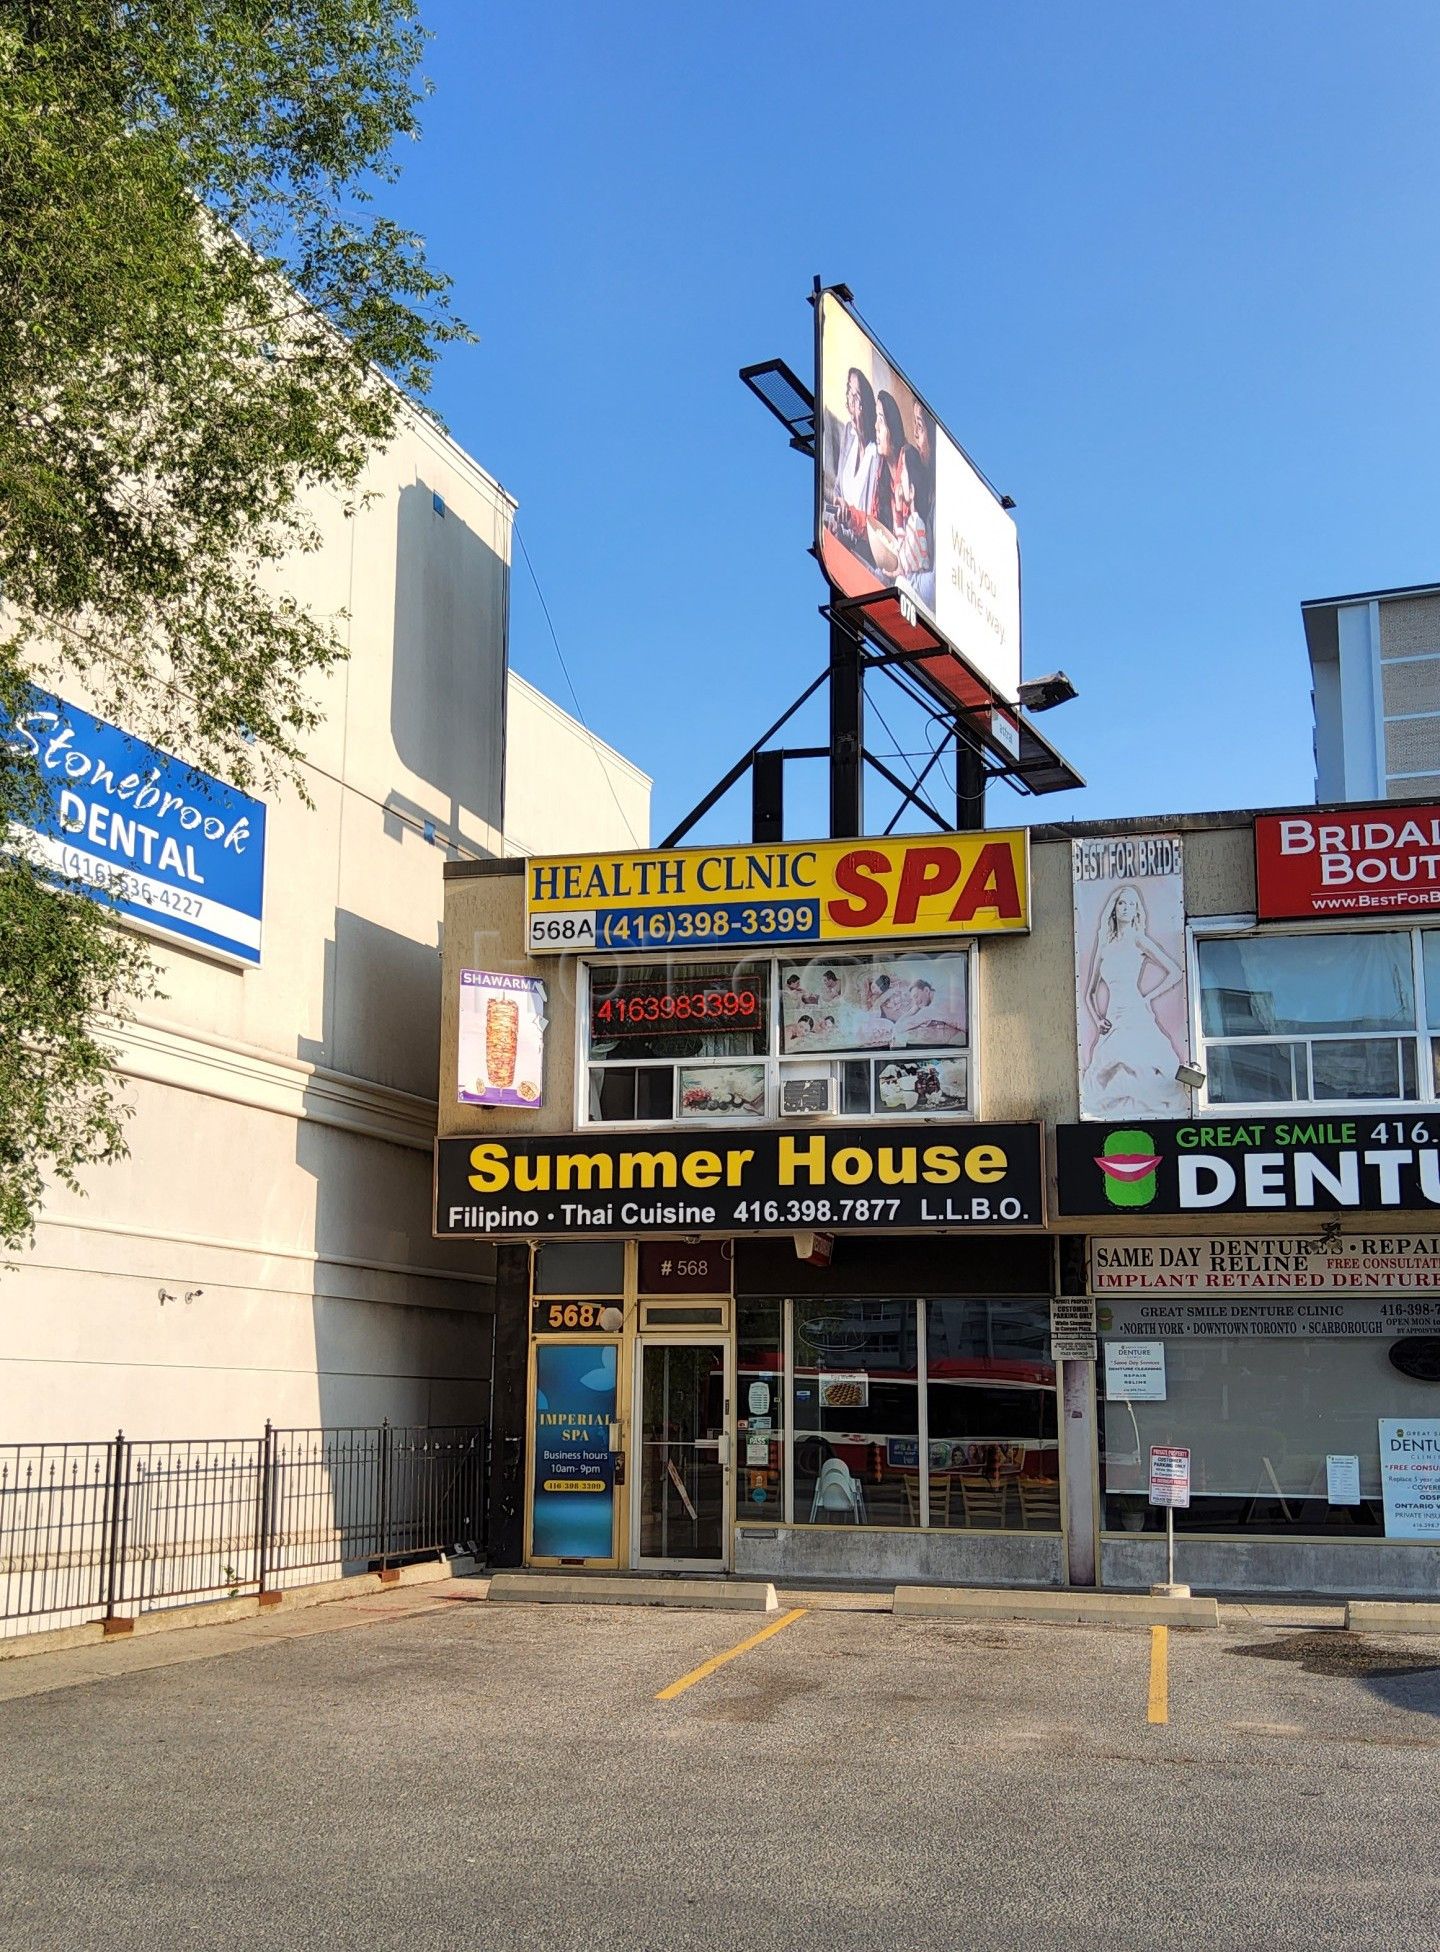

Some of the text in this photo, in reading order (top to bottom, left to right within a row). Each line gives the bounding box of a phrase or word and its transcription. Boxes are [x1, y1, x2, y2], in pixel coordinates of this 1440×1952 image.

[951, 523, 997, 598] With you
[951, 564, 964, 594] all
[966, 580, 983, 616] the
[10, 711, 250, 855] Stonebrook
[59, 789, 205, 884] DENTAL
[1074, 839, 1181, 881] BEST FOR BRIDE
[532, 852, 817, 900] HEALTH CLNIC
[828, 842, 1022, 928] SPA
[532, 906, 813, 945] 568A (416)398-3399
[598, 990, 756, 1025] 4163983399
[1176, 1126, 1266, 1148] GREAT
[1275, 1122, 1357, 1146] SMILE
[468, 1135, 1008, 1194] Summer House
[448, 1197, 1030, 1232] Filipino Thai Cuisine 416.398.7877 L.L.B.O.
[677, 1260, 709, 1276] 568
[1097, 1248, 1154, 1268] SAME
[1159, 1247, 1202, 1267] DAY
[1210, 1239, 1344, 1257] DENTURES
[1210, 1256, 1308, 1272] RELINE
[1326, 1258, 1360, 1269] FREE
[1096, 1275, 1198, 1288] IMPLANT
[1206, 1273, 1325, 1287] RETAINED
[1140, 1307, 1184, 1317] GREAT
[1187, 1307, 1228, 1317] SMILE
[1231, 1307, 1294, 1317] DENTURE
[1297, 1306, 1344, 1316] CLINIC
[1159, 1322, 1184, 1334] YORK
[1193, 1322, 1249, 1334] DOWNTOWN
[1252, 1321, 1297, 1333] TORONTO
[1308, 1321, 1383, 1333] SCARBOROUGH
[540, 1413, 610, 1426] IMPERIAL
[562, 1429, 589, 1441] SPA
[749, 1437, 766, 1445] PASS
[543, 1450, 608, 1460] Business hours
[580, 1464, 600, 1475] 9pm
